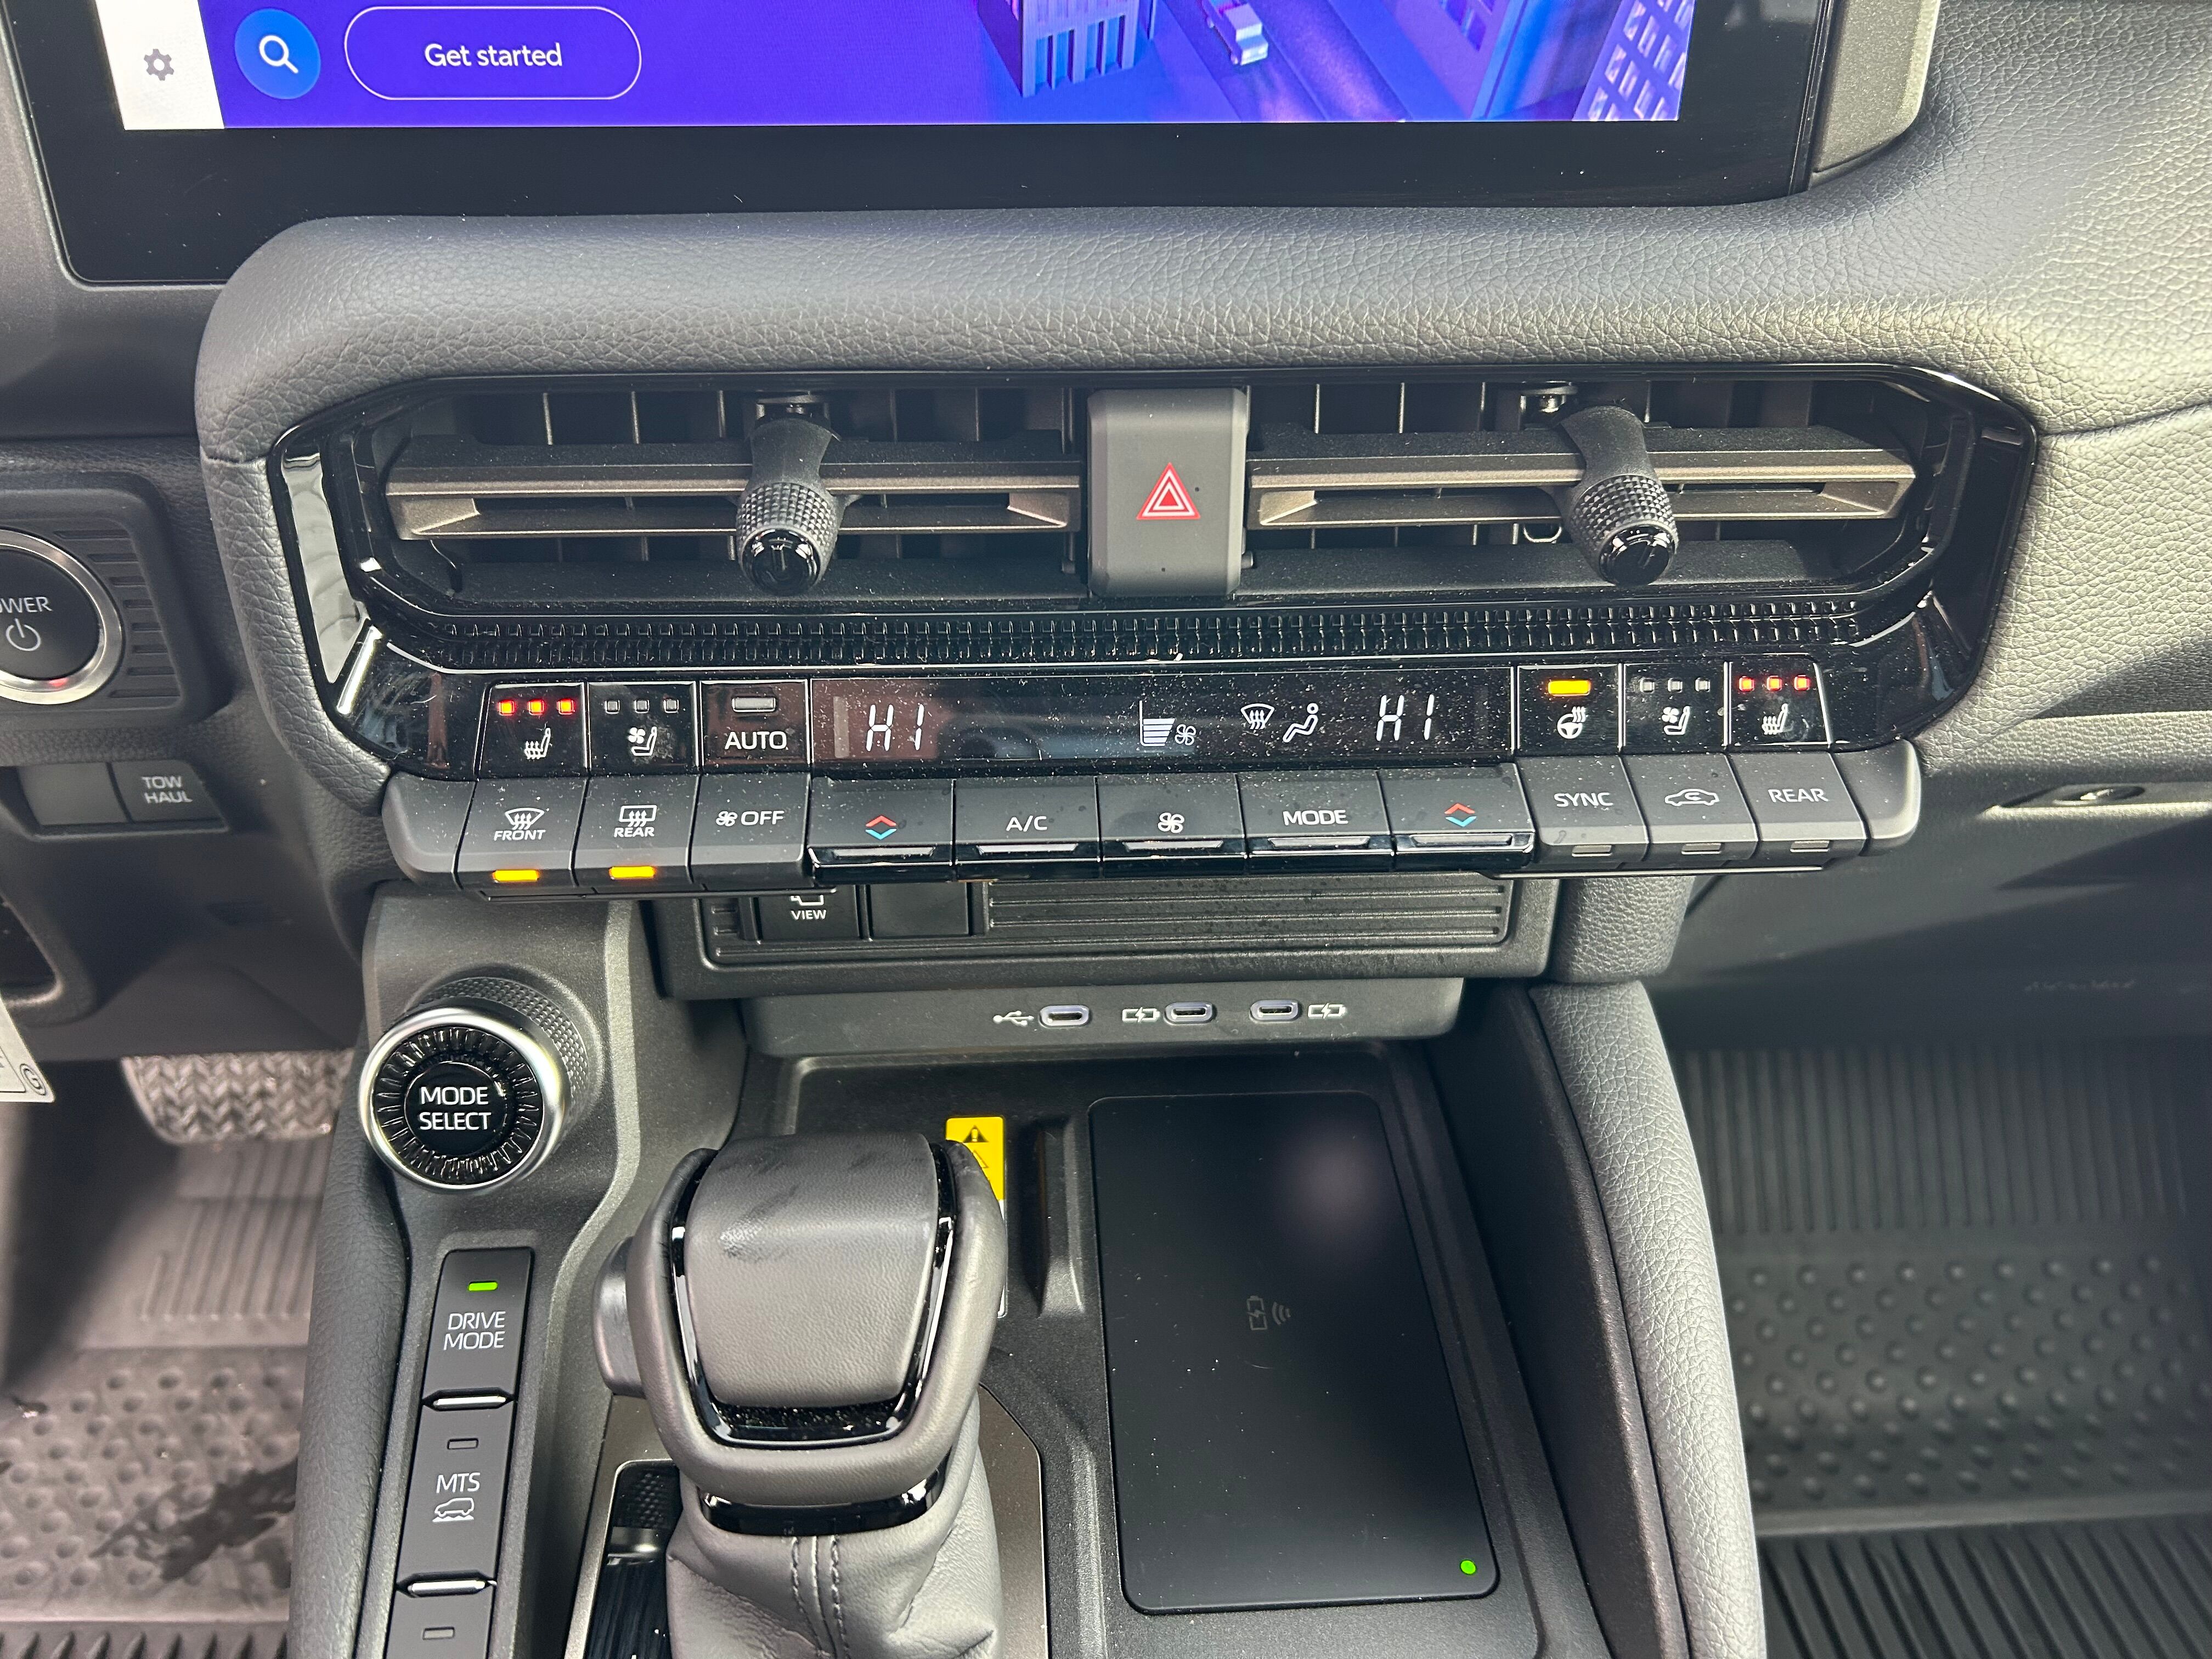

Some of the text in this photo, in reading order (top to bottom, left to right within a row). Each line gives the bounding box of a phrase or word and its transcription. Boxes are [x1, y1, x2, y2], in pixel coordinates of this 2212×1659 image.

[425, 43, 562, 66] Get started
[0, 596, 52, 613] WER
[1376, 694, 1435, 741] HI
[866, 702, 924, 752] HI
[724, 731, 787, 750] AUTO
[141, 776, 182, 788] TOW
[144, 791, 193, 804] HAUL
[1554, 792, 1614, 807] SYNC
[1769, 788, 1829, 803] REAR
[741, 810, 785, 826] OFF
[1006, 815, 1048, 832] A/C
[1283, 809, 1348, 826] MODE
[493, 829, 546, 841] FRONT
[613, 827, 655, 838] REAR
[791, 909, 827, 920] VIEW
[421, 1086, 489, 1105] MODE
[419, 1111, 492, 1130] SELECT
[448, 1311, 506, 1330] DRIVE
[443, 1331, 505, 1351] MODE
[436, 1472, 481, 1493] MTS
